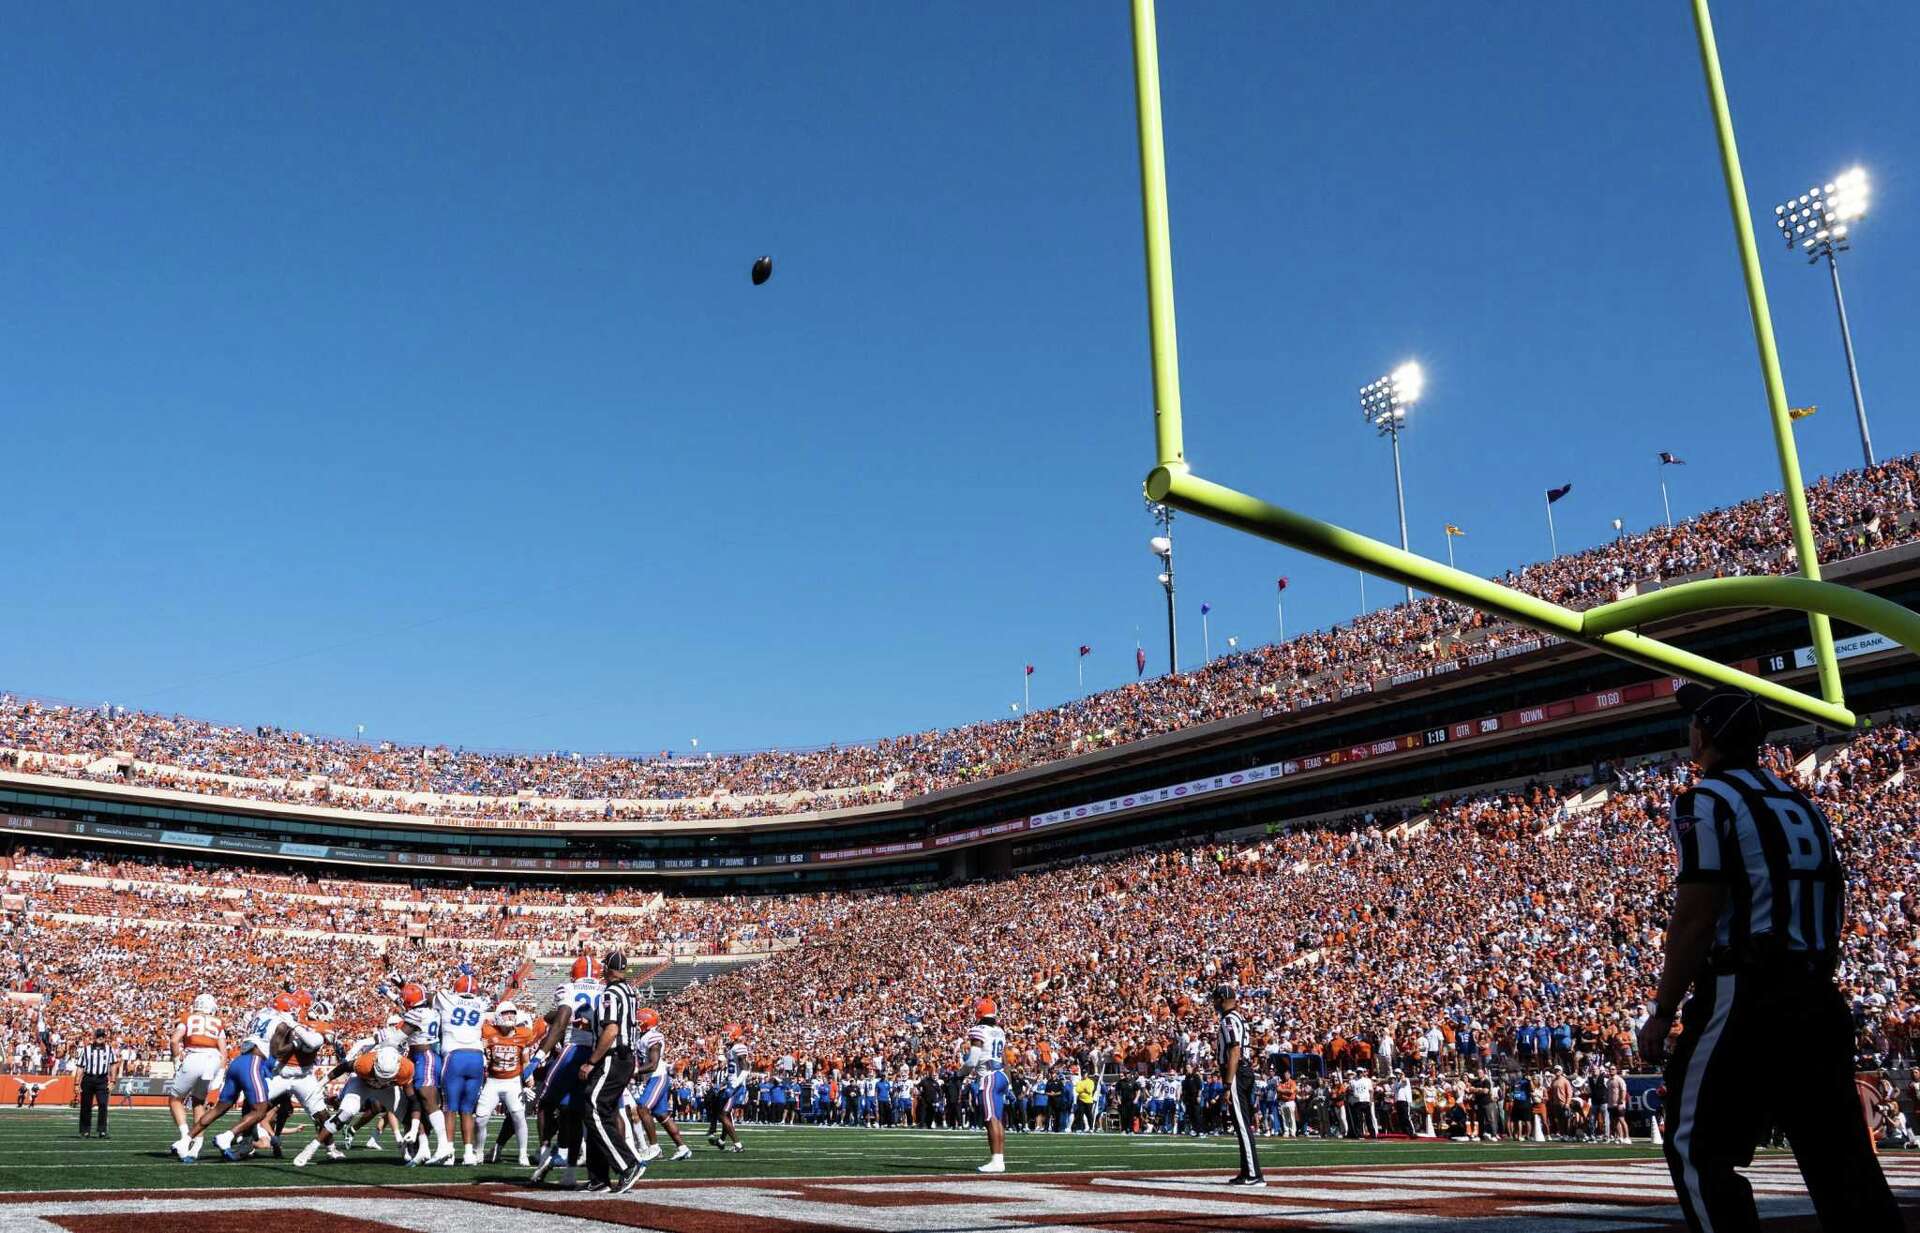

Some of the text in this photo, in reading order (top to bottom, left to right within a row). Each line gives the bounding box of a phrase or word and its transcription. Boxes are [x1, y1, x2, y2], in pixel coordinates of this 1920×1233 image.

[1835, 637, 1885, 654] ENCE BANK
[1468, 652, 1494, 667] TEXAS
[1769, 656, 1785, 671] 16
[1597, 692, 1620, 708] TO GO
[1520, 709, 1543, 724] DOWN
[1456, 724, 1470, 737] QTR
[1480, 718, 1498, 733] 2ND
[1372, 740, 1397, 755] FLORIDA
[1303, 756, 1322, 770] TEXAS
[1771, 798, 1823, 872] B
[417, 854, 436, 864] TEXAS
[632, 859, 655, 869] FLORIDA
[450, 1007, 480, 1027] 99
[186, 1014, 222, 1040] 85
